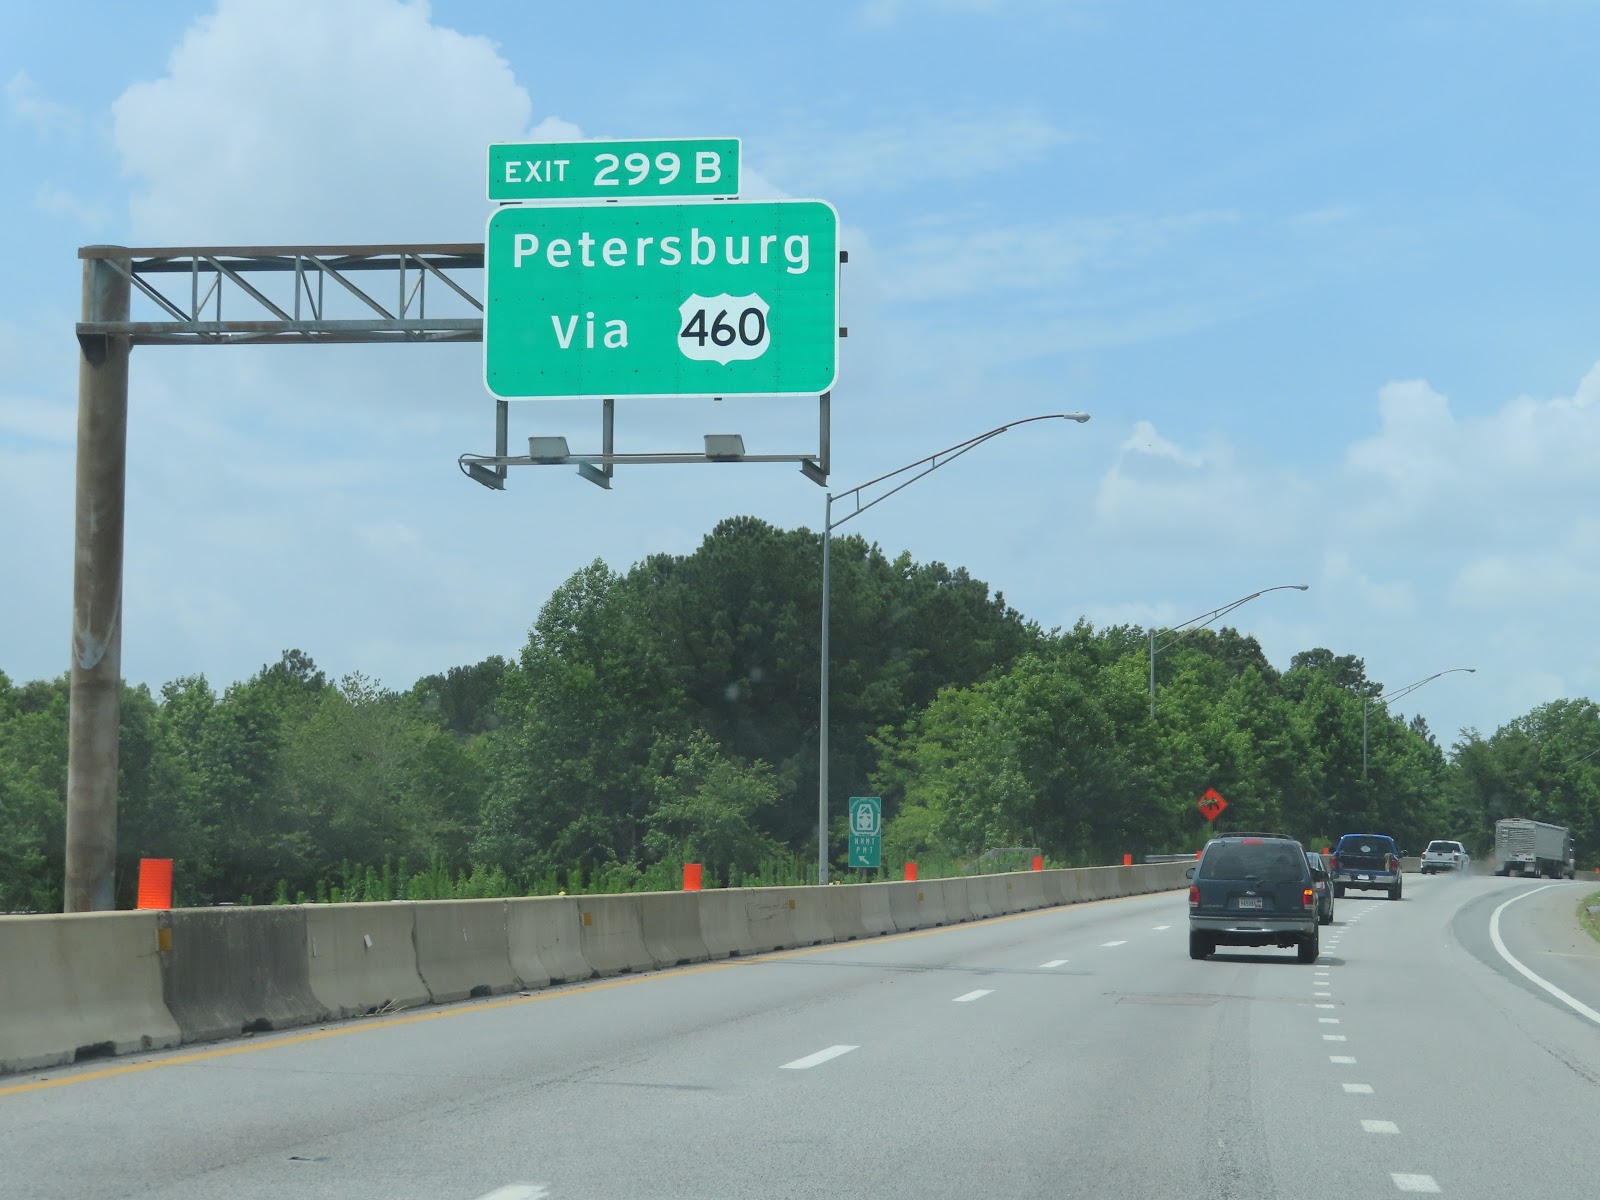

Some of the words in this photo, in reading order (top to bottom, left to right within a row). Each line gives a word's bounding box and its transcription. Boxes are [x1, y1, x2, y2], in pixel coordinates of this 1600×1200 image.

[505, 159, 570, 183] EXIT
[593, 152, 681, 186] 299
[695, 151, 722, 184] B
[513, 228, 810, 275] Petersburg
[551, 312, 629, 349] Via
[680, 307, 766, 347] 460
